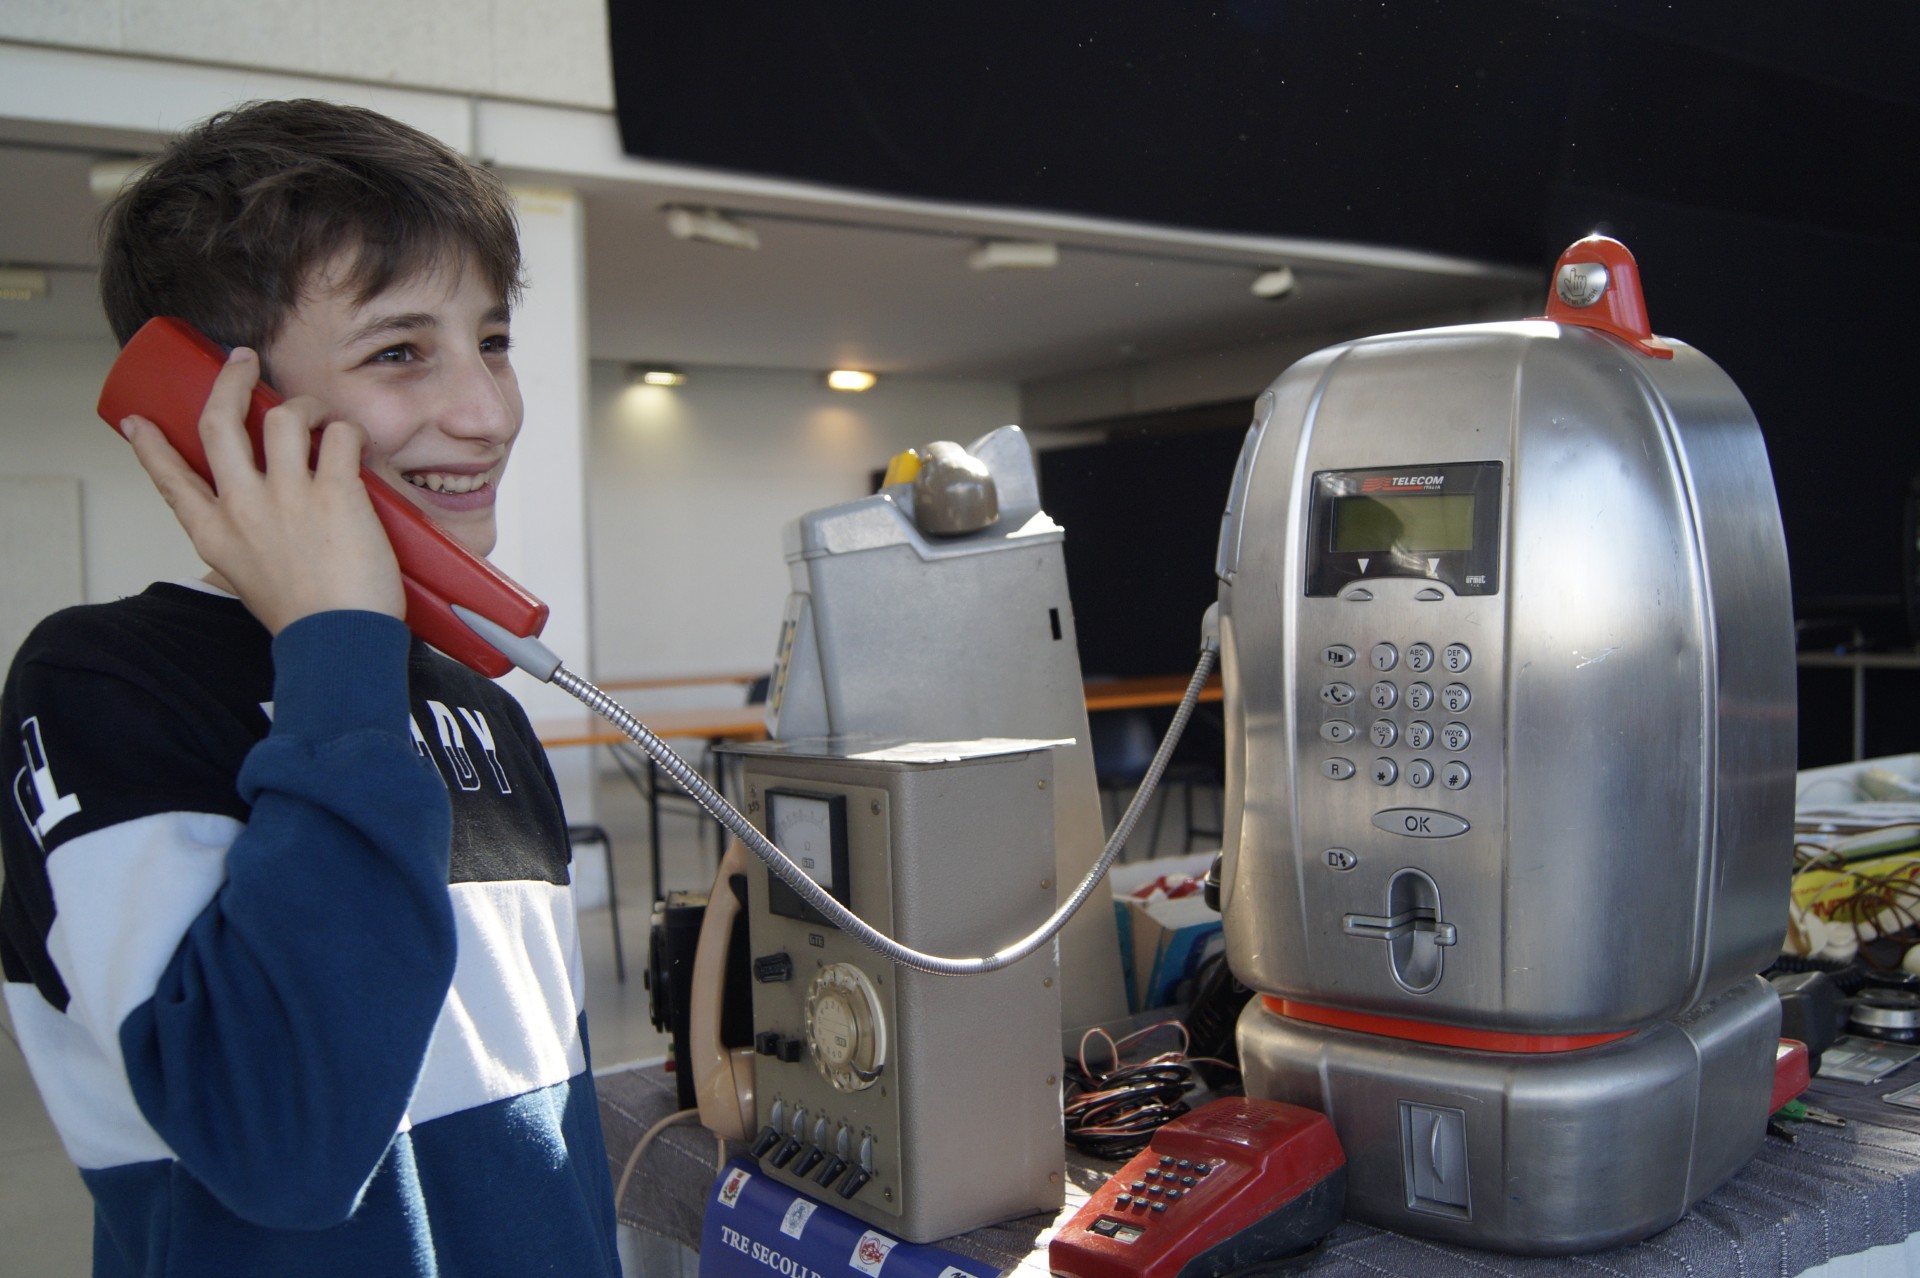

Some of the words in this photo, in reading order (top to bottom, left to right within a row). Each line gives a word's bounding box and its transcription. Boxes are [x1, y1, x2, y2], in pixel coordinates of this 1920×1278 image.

[1392, 476, 1444, 486] TELECOM
[1410, 649, 1424, 657] ABC
[1447, 649, 1461, 657] DEF
[1379, 657, 1384, 668] 1
[1413, 657, 1421, 668] 2
[1450, 658, 1458, 669] 3
[1377, 696, 1385, 707] 4
[1412, 697, 1420, 708] 5
[1450, 699, 1458, 710] 6
[1331, 726, 1339, 738] C
[1379, 734, 1386, 745] 7
[1413, 736, 1421, 747] 8
[1450, 737, 1458, 748] 9
[1331, 764, 1339, 775] R
[1412, 773, 1420, 785] 0
[1448, 775, 1459, 786] #
[1404, 815, 1431, 833] OK
[808, 933, 825, 948] GTE
[721, 1225, 750, 1254] TRE
